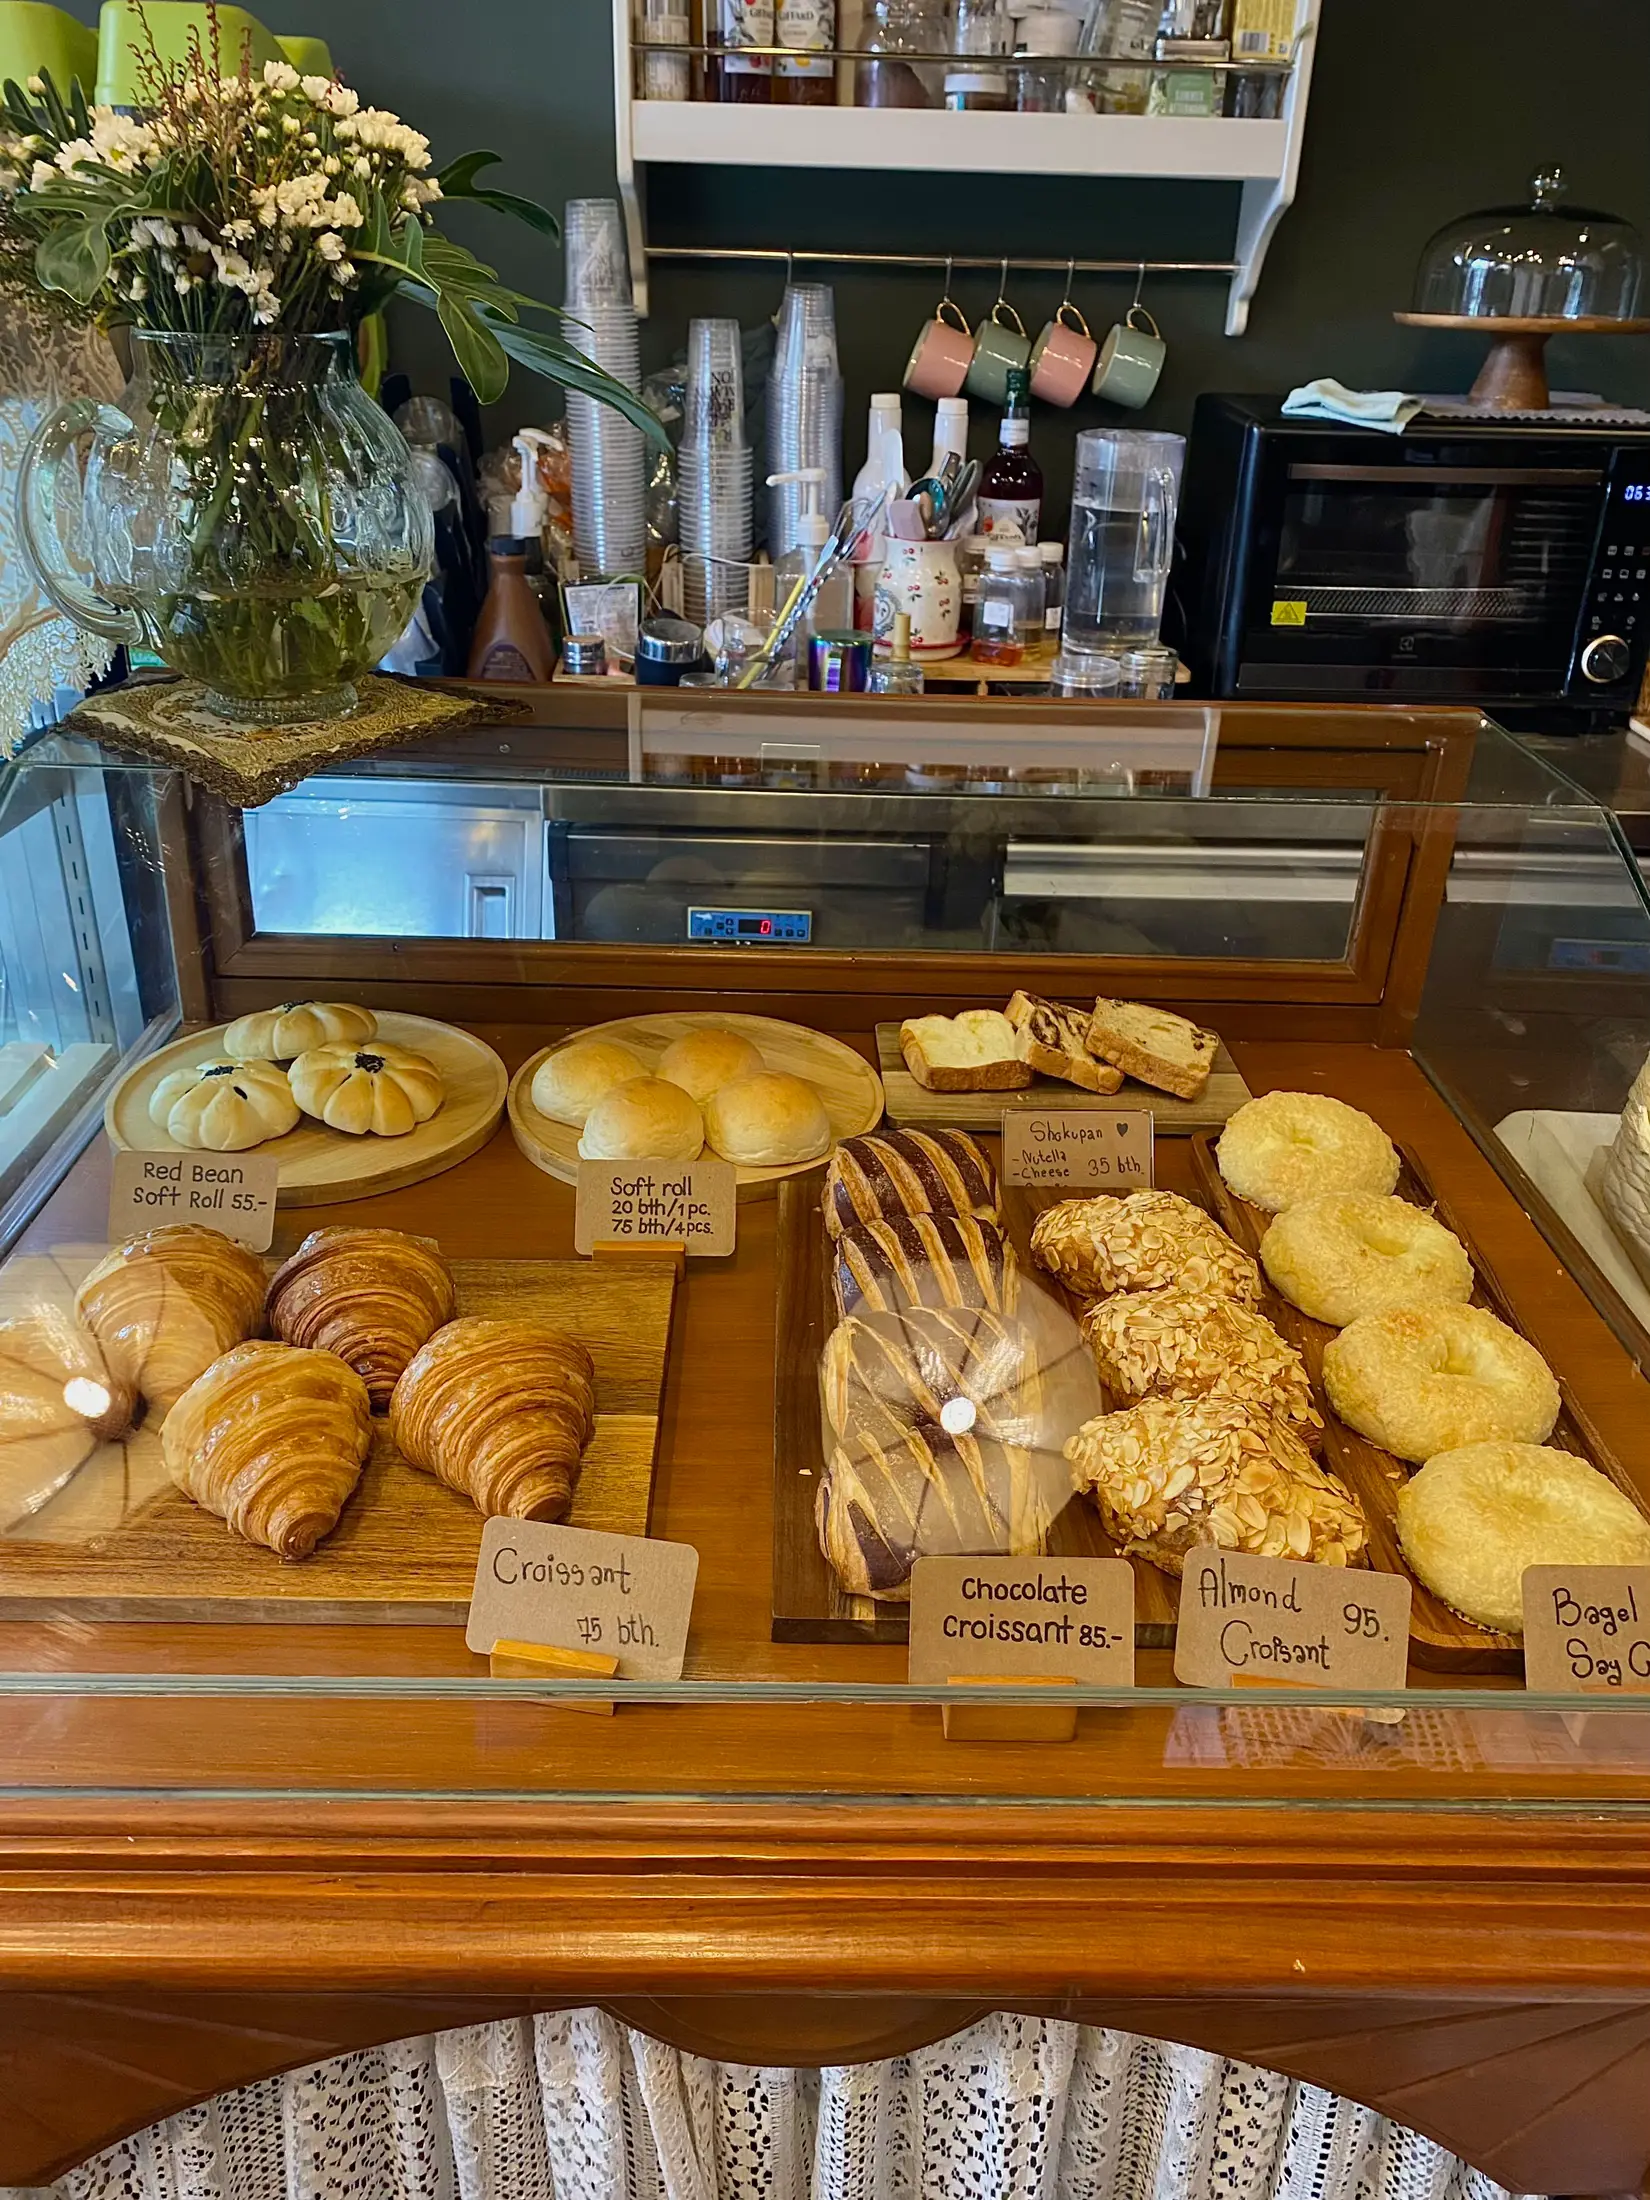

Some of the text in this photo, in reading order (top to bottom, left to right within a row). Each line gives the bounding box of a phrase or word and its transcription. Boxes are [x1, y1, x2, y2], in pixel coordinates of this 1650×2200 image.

[144, 1160, 244, 1184] Red Bean
[1088, 1156, 1145, 1177] 35 bth.
[132, 1185, 268, 1212] Soft Roll 55.-
[610, 1175, 692, 1197] Soft roll
[611, 1200, 633, 1215] 20
[611, 1218, 633, 1234] 75
[493, 1547, 631, 1595] Croissant
[1198, 1557, 1302, 1613] Almond
[961, 1573, 1088, 1605] Chocolate
[1343, 1603, 1389, 1642] 95.
[1552, 1585, 1638, 1636] Bagel
[576, 1613, 660, 1647] 75 bth.
[943, 1613, 1123, 1649] Croissant 85.-
[1566, 1638, 1622, 1686] Say
